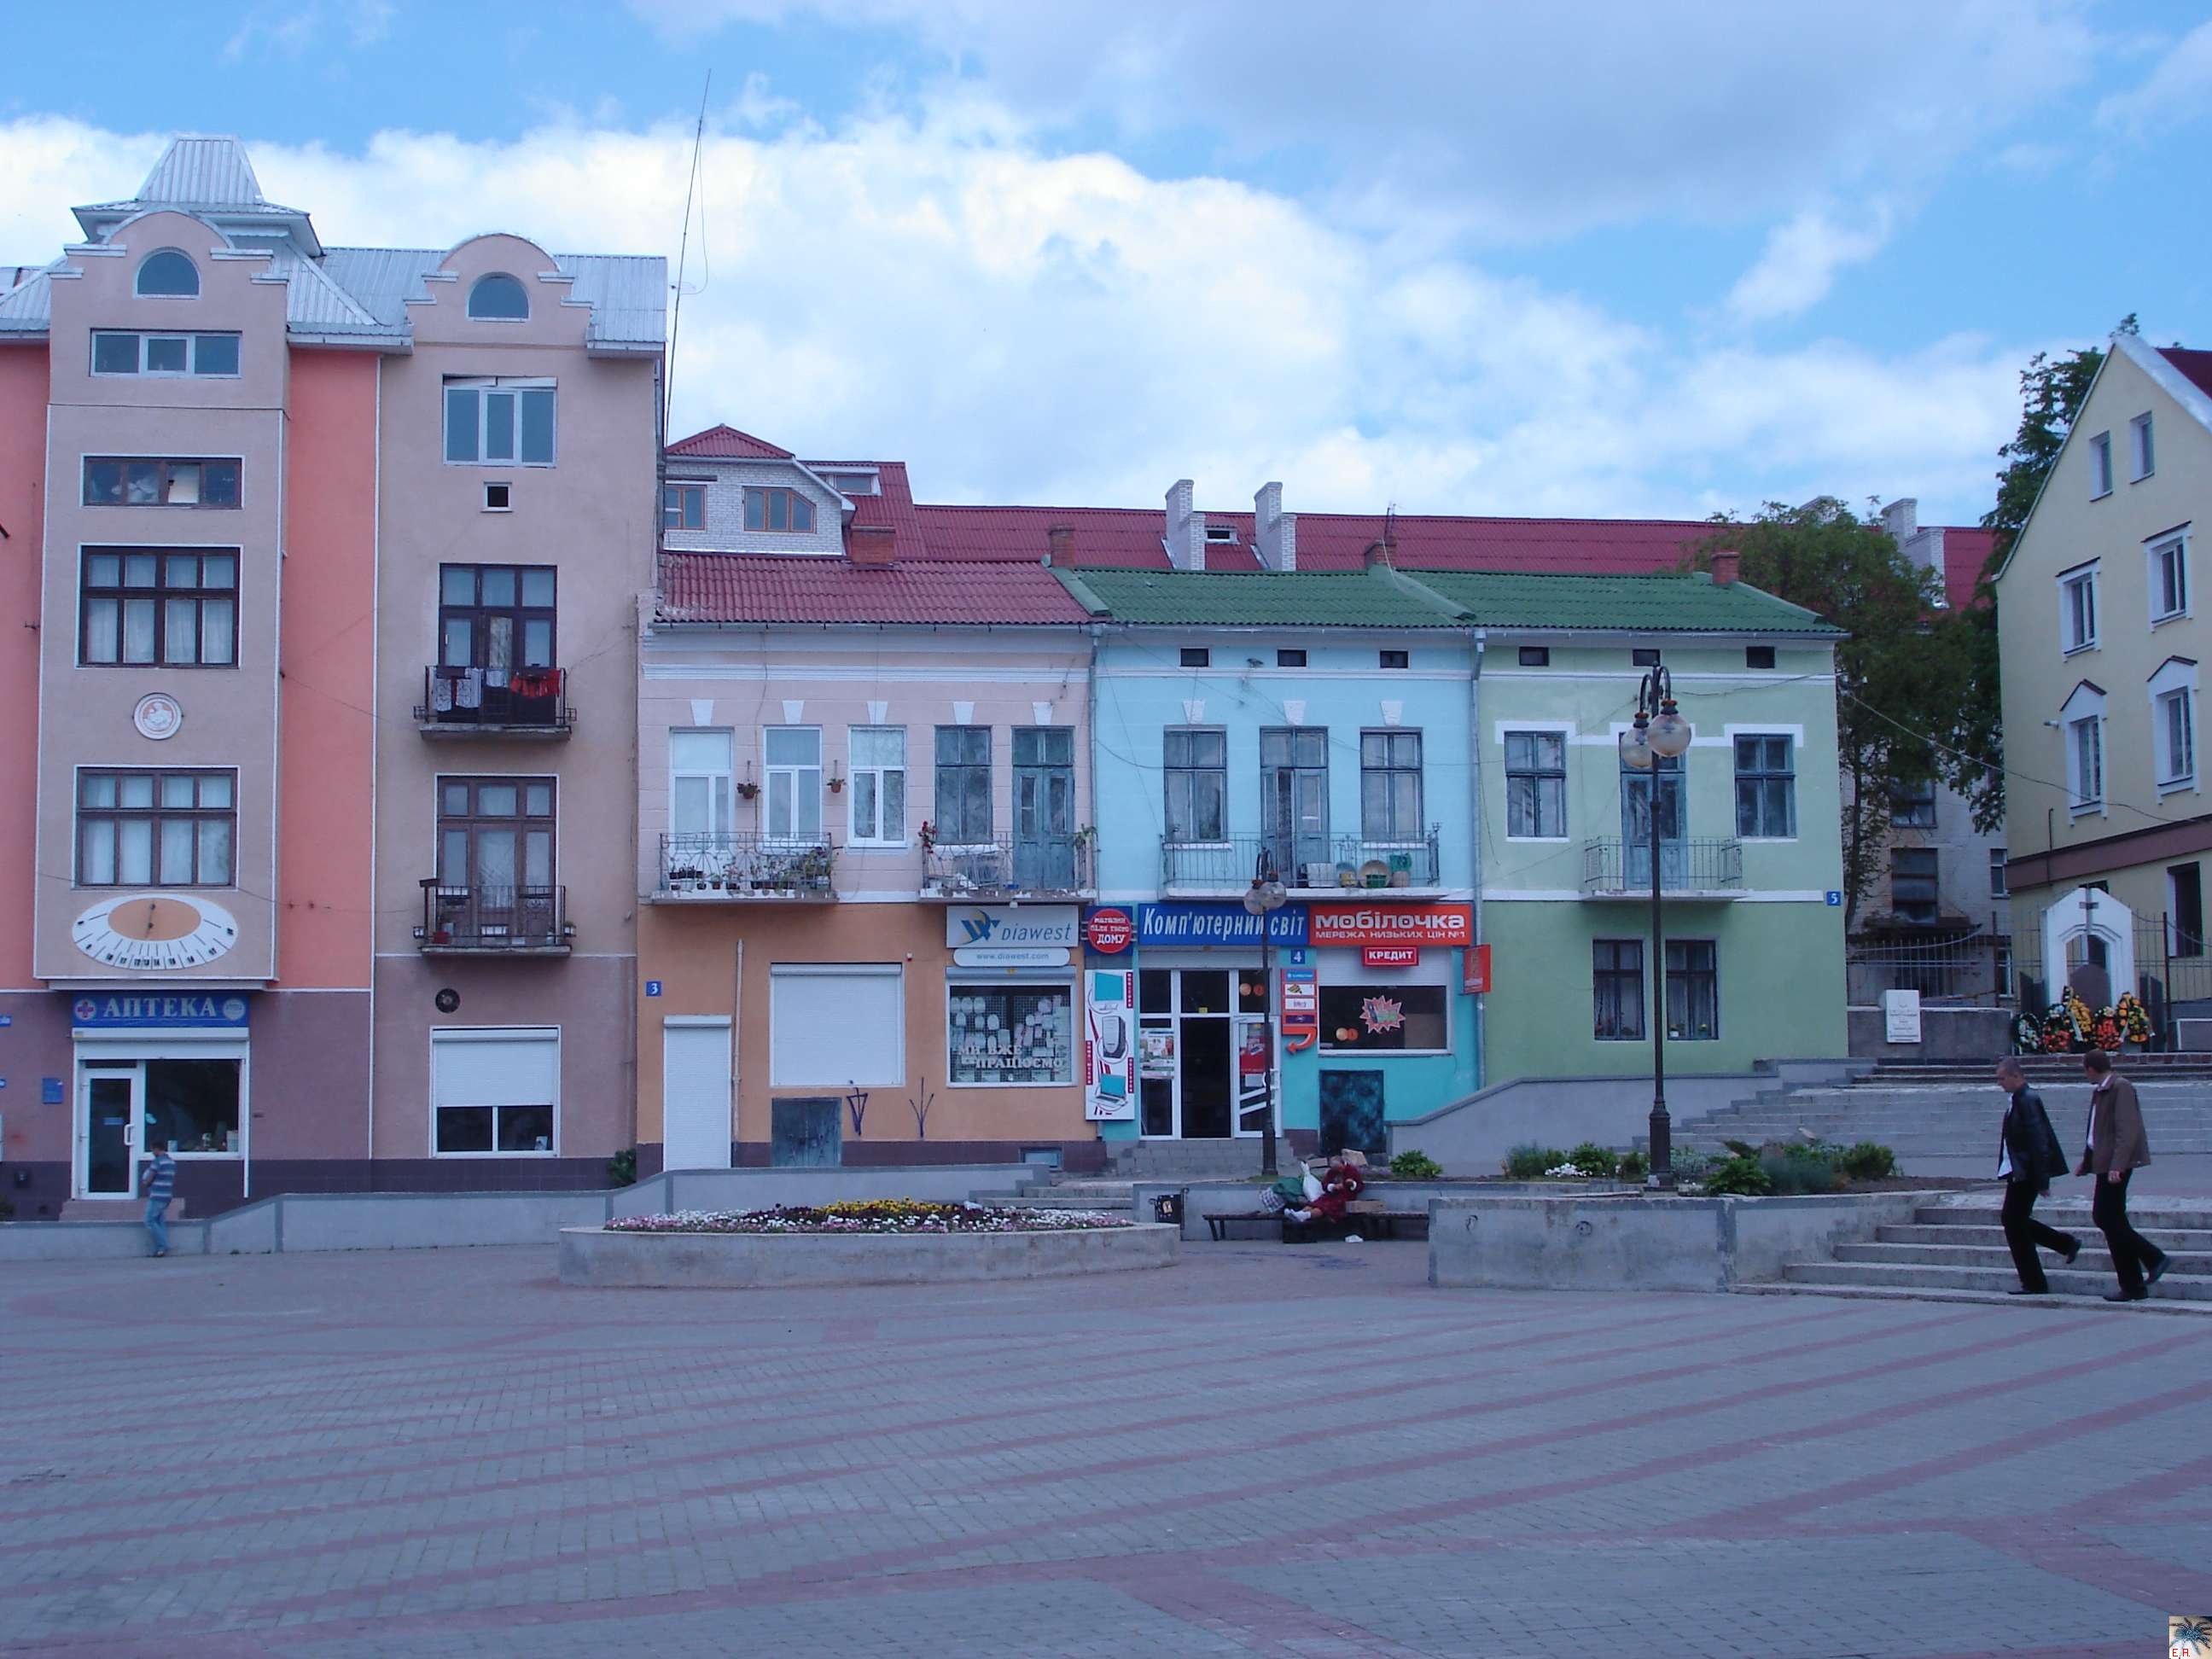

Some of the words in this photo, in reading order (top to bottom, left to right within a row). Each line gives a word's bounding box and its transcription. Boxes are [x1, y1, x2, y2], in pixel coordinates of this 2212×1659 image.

[1831, 893, 1838, 904] 5
[1270, 909, 1305, 936] світ
[1097, 934, 1126, 945] ДОМУ
[1427, 931, 1446, 940] ЦІН
[1294, 951, 1302, 963] 4
[1369, 950, 1414, 961] КРЕДИТ
[651, 982, 659, 995] 3
[103, 997, 217, 1018] АПТЕКА
